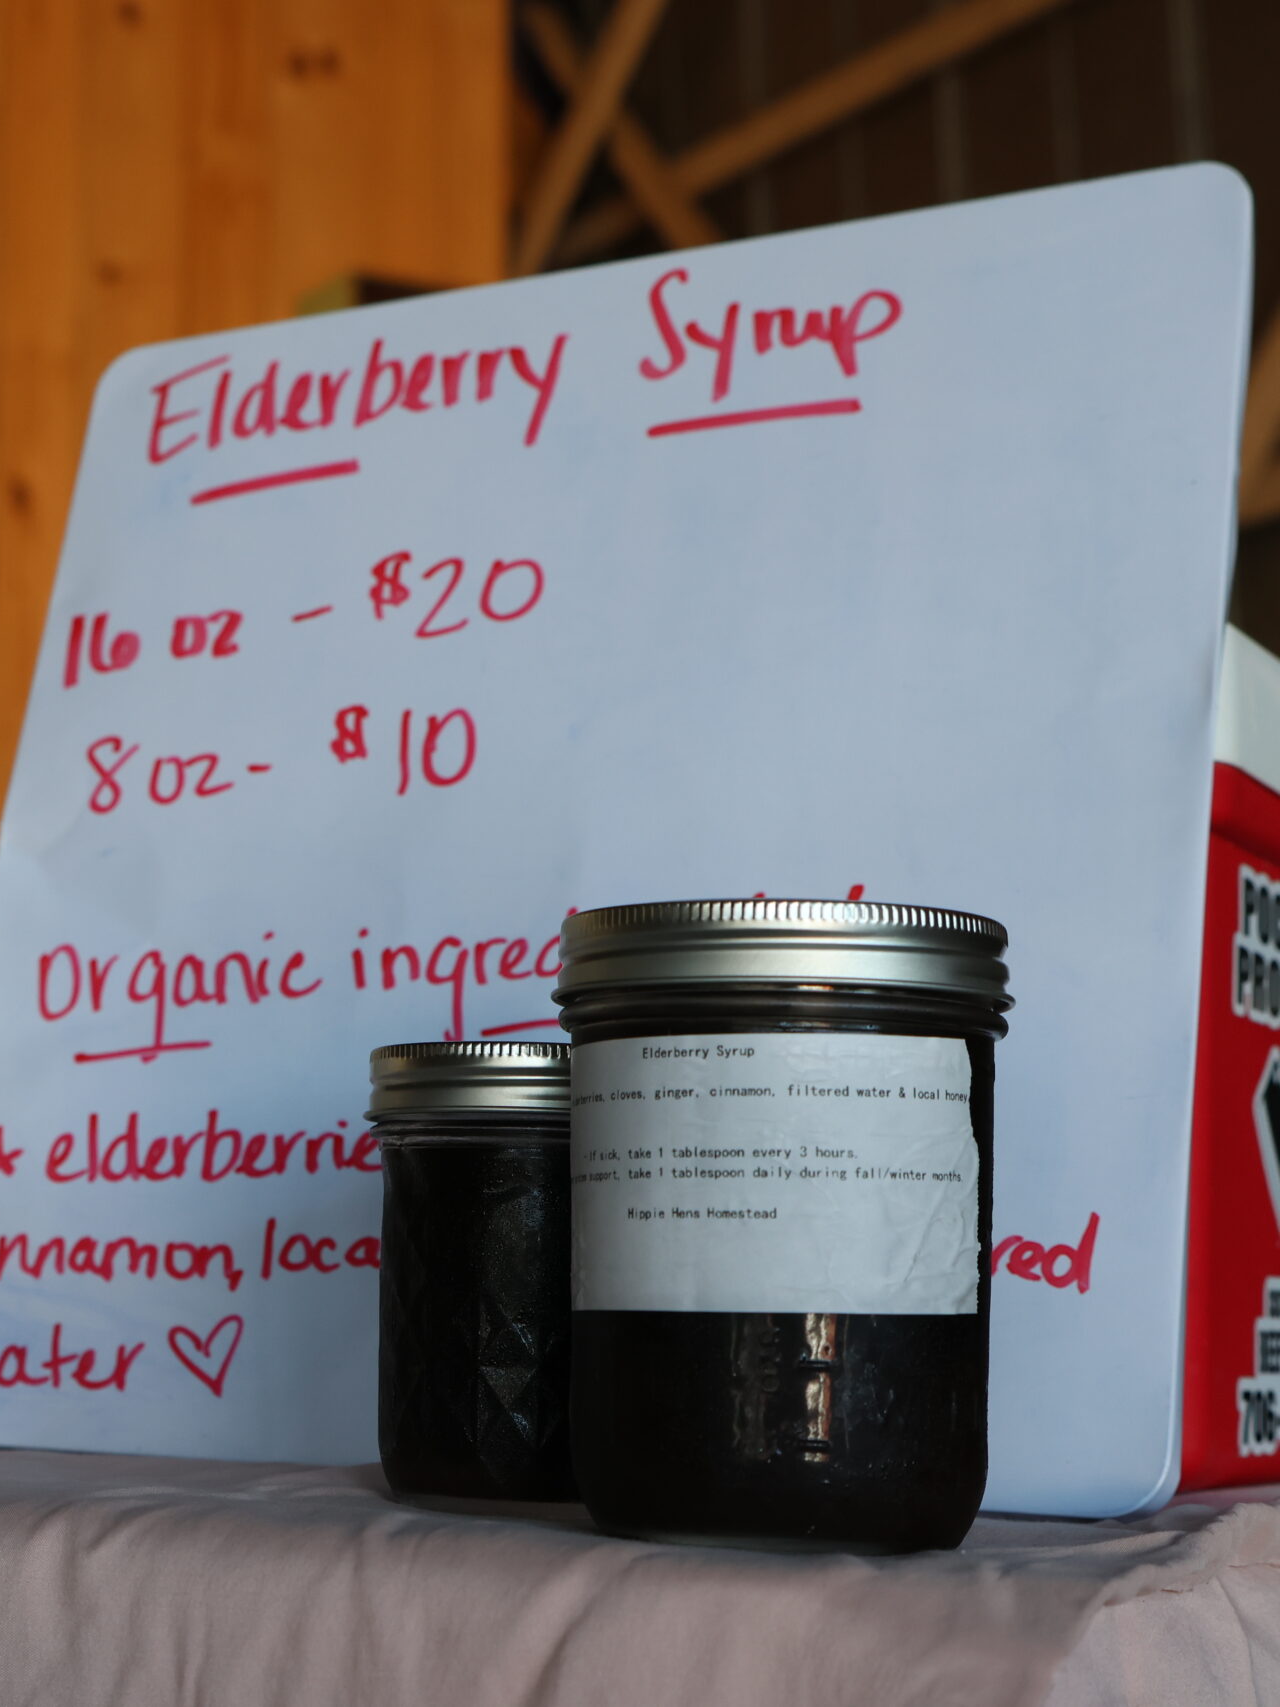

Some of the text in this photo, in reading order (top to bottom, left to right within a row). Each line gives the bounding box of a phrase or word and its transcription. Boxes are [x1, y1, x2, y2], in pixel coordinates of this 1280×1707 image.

[148, 267, 903, 464] Elderberry Syrup
[63, 612, 141, 688] 16
[171, 612, 243, 658] oz
[369, 551, 545, 638] $20
[87, 736, 141, 814] 8
[331, 704, 477, 796] $10
[38, 931, 322, 1062] Organic
[352, 907, 577, 1042] ingred
[642, 1044, 755, 1060] Elderberry Syrup
[655, 1087, 700, 1100] ginger,
[710, 1086, 776, 1098] cinnamon,
[787, 1084, 850, 1097] filtered
[856, 1086, 891, 1098] water
[898, 1087, 906, 1099] &
[913, 1088, 940, 1100] local
[46, 1111, 382, 1182] elderberrie
[628, 1149, 652, 1160] take
[659, 1148, 664, 1158] 1
[672, 1147, 745, 1161] tablespoon
[752, 1150, 792, 1162] every
[800, 1146, 808, 1158] 3
[628, 1169, 652, 1180] take
[659, 1168, 664, 1178] 1
[672, 1167, 745, 1181] tablespoon
[752, 1167, 792, 1181] daily
[800, 1167, 848, 1181] during
[855, 1167, 926, 1182] fall/winter
[627, 1207, 778, 1221] Hippie Hens Homestead
[261, 1217, 381, 1281] loca
[990, 1211, 1101, 1295] red
